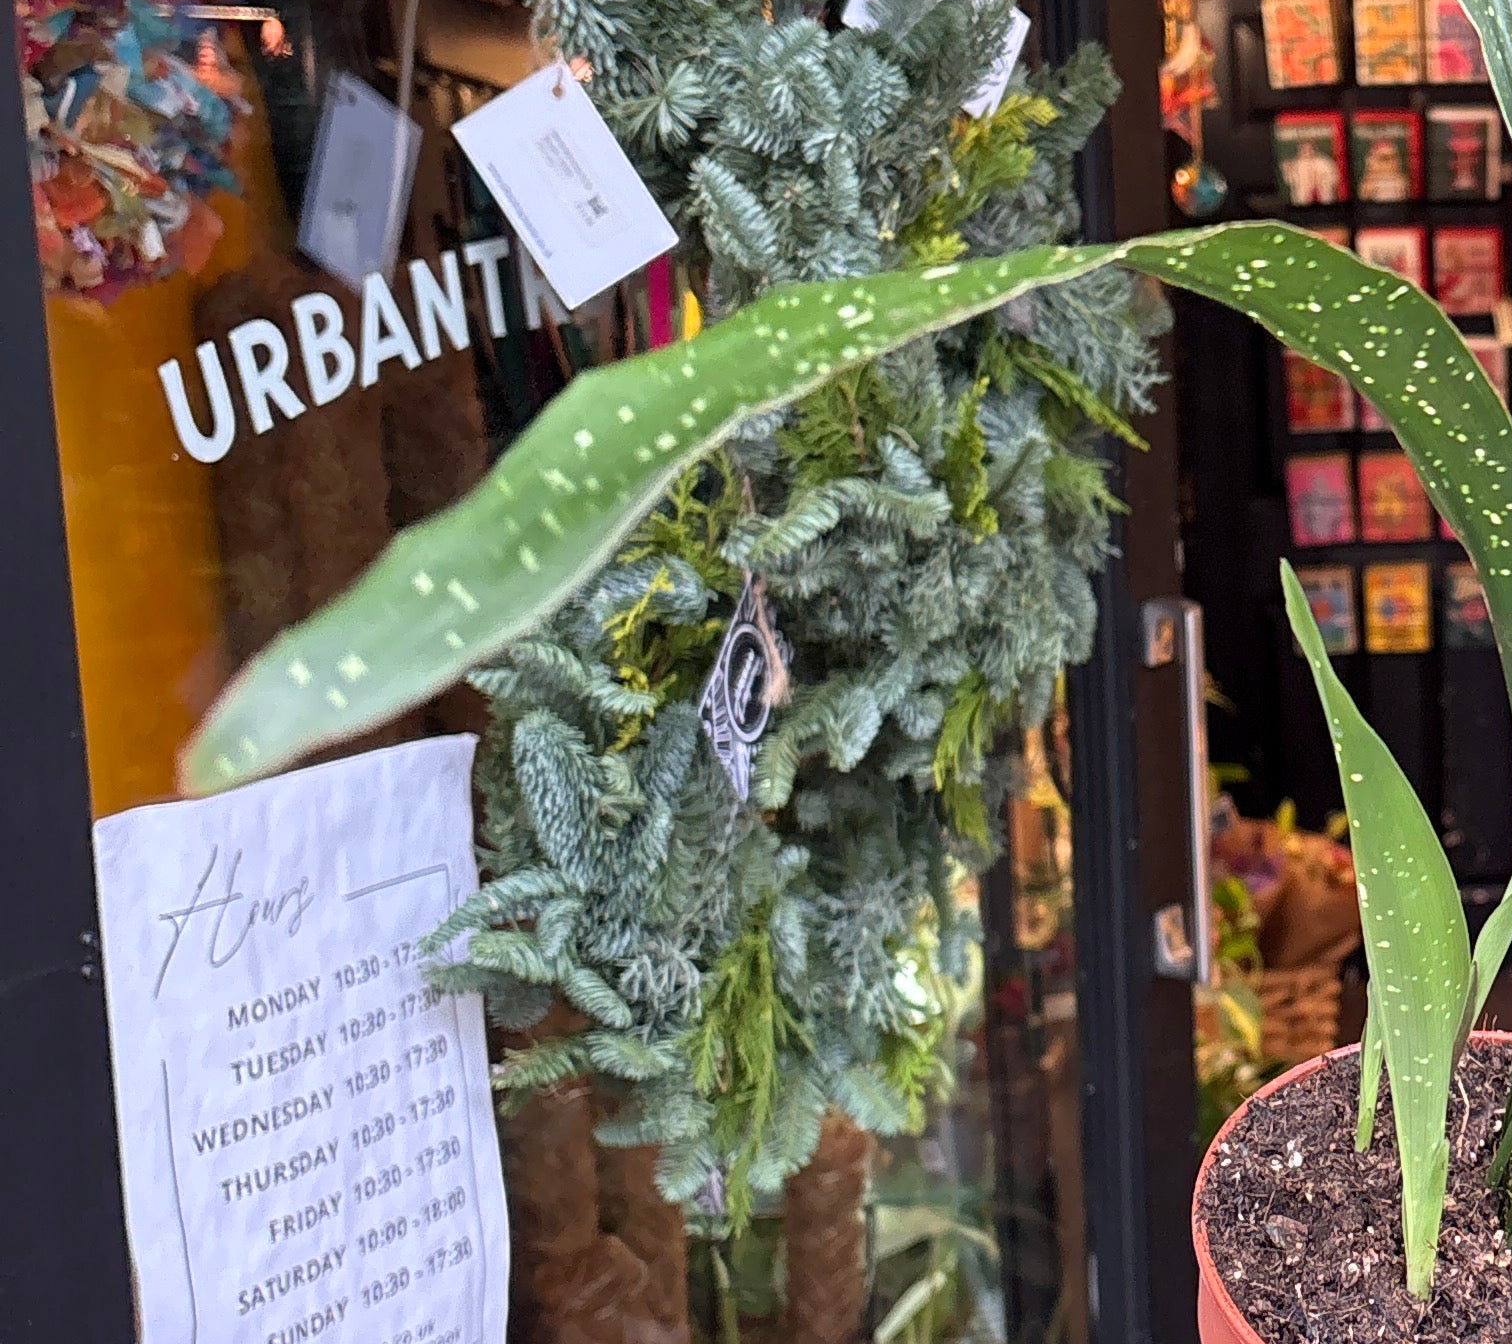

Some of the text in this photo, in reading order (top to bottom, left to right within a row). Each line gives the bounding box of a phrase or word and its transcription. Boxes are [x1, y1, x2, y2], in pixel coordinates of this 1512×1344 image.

[226, 975, 321, 1031] MONDAY
[334, 953, 380, 992] 10:30
[229, 1029, 328, 1085] TUESDAY
[339, 1006, 386, 1046] 10:30
[399, 984, 443, 1020] 17:30
[191, 1083, 334, 1156] WEDNESDAY
[345, 1059, 391, 1099] 10:30
[403, 1033, 449, 1071] 17:30
[219, 1135, 340, 1204] THURSDAY
[351, 1111, 396, 1152] 10:30
[408, 1084, 456, 1125] 17:30
[268, 1190, 343, 1244] FRIDAY
[353, 1163, 402, 1205] 10:30
[415, 1135, 462, 1175] 17:30
[237, 1243, 347, 1317] SATURDAY
[356, 1215, 408, 1256] 10:00
[422, 1184, 467, 1226] 18:00
[361, 1265, 411, 1309] 10:30
[425, 1235, 473, 1278] 17:30
